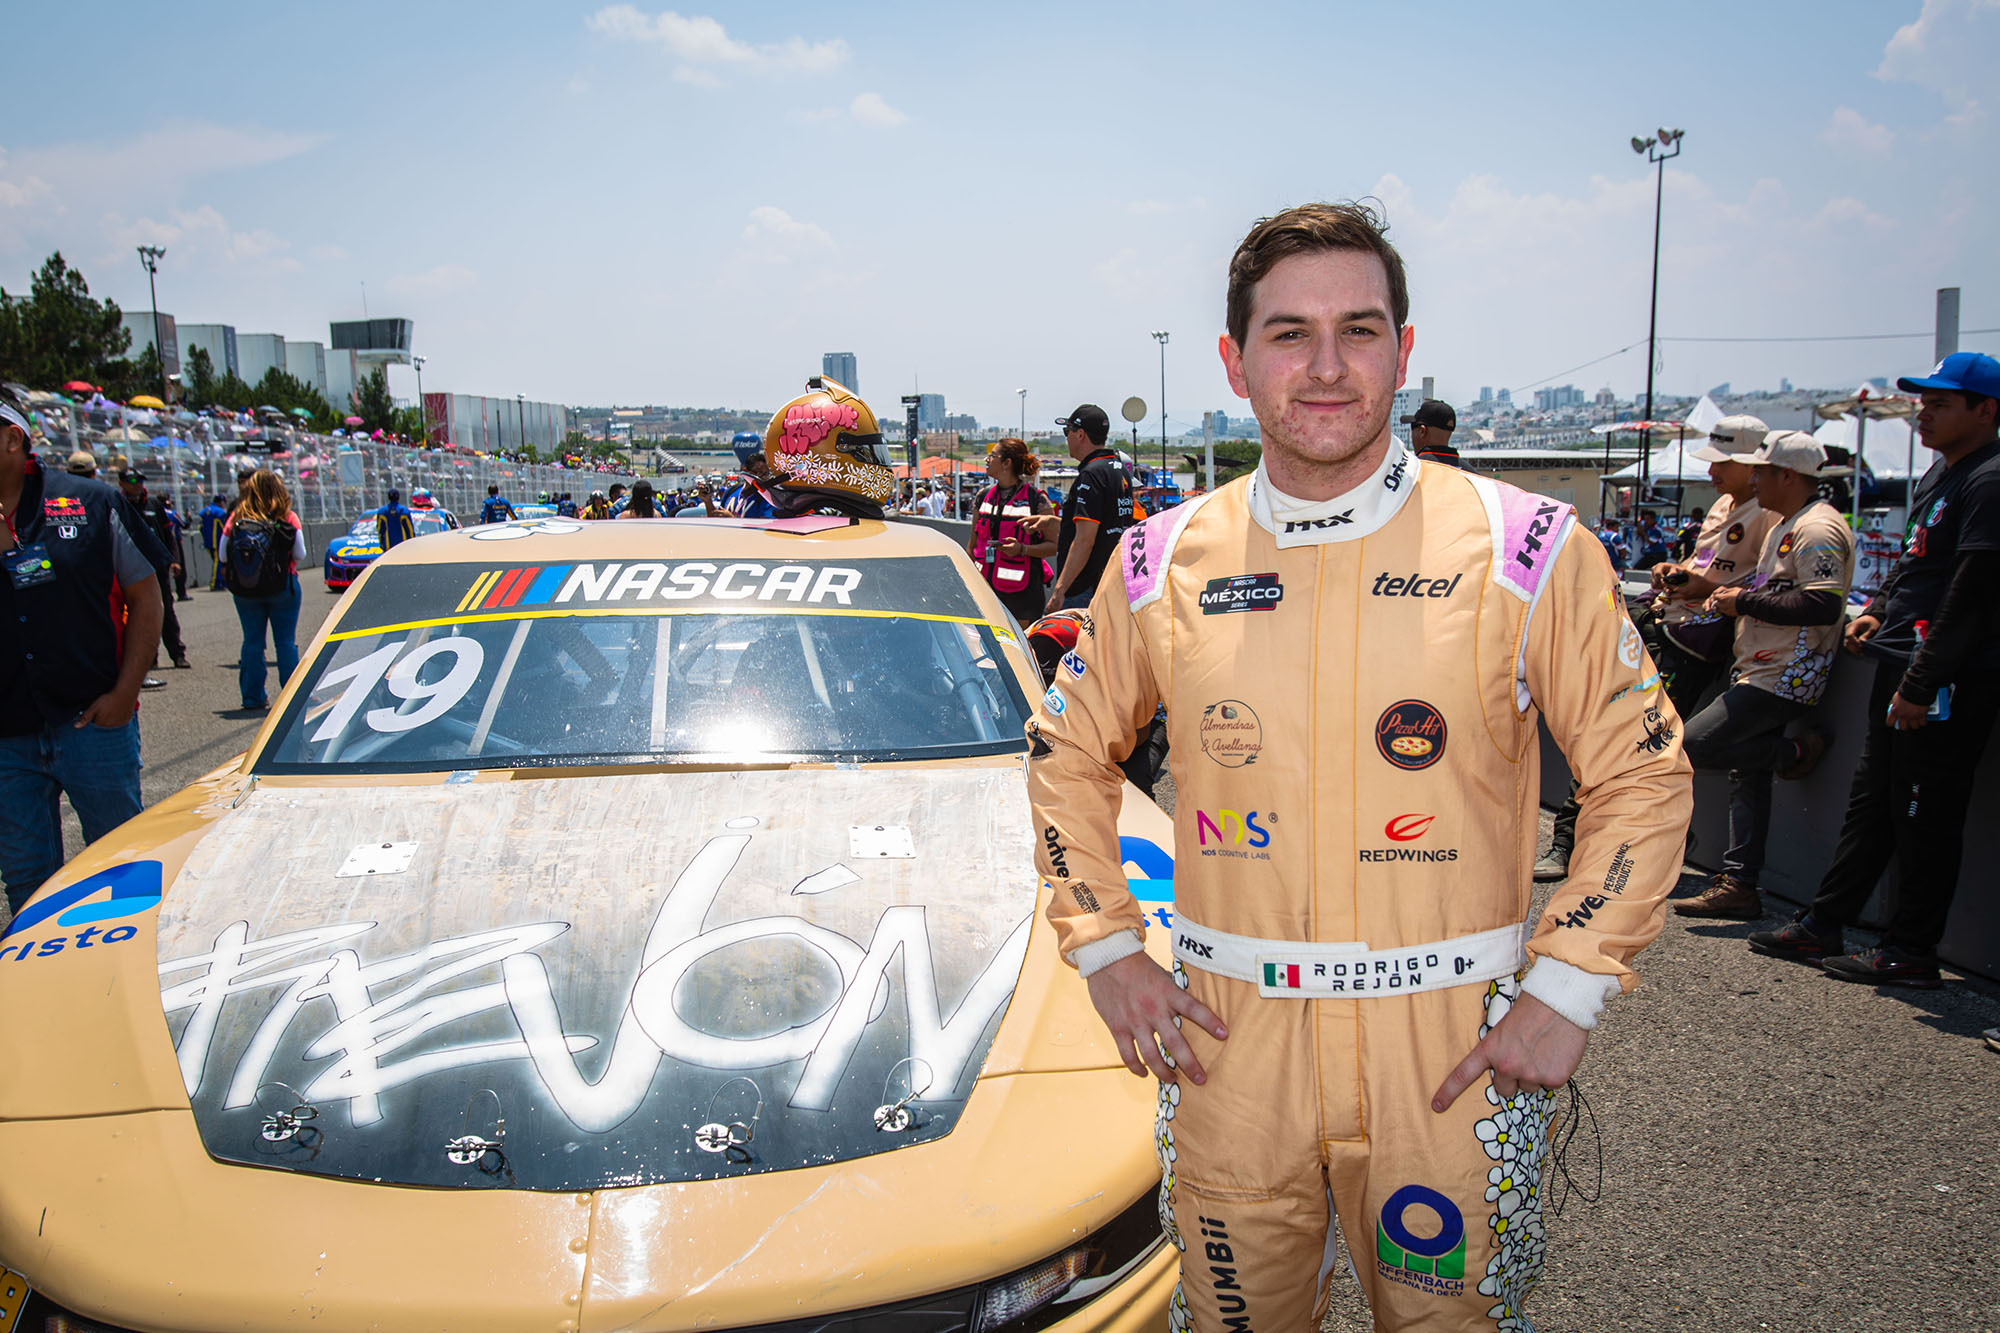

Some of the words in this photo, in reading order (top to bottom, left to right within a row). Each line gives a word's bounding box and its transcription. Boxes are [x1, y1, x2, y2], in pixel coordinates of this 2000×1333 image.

[1515, 501, 1559, 570] HRX
[1131, 521, 1149, 579] HRX
[555, 563, 863, 605] NASCAR
[1200, 587, 1281, 604] MÉXICO
[1372, 572, 1463, 598] telcel
[1230, 601, 1249, 609] SERIES
[310, 636, 484, 742] 19
[1200, 718, 1256, 731] Almendras
[1201, 738, 1209, 752] &
[1212, 738, 1263, 751] Avellanas
[1196, 808, 1270, 848] NDS
[1201, 849, 1217, 857] NDS
[1250, 852, 1271, 860] LABS
[1359, 848, 1459, 862] REDWINGS
[1603, 843, 1632, 892] PERFORMANCE
[1613, 858, 1635, 896] PRODUCTS
[1178, 934, 1214, 960] HRX
[1314, 953, 1438, 976] RODRIGO
[1376, 1260, 1464, 1291] OFFENBACH
[1377, 1269, 1421, 1290] MEXICANA
[1422, 1285, 1435, 1295] SA
